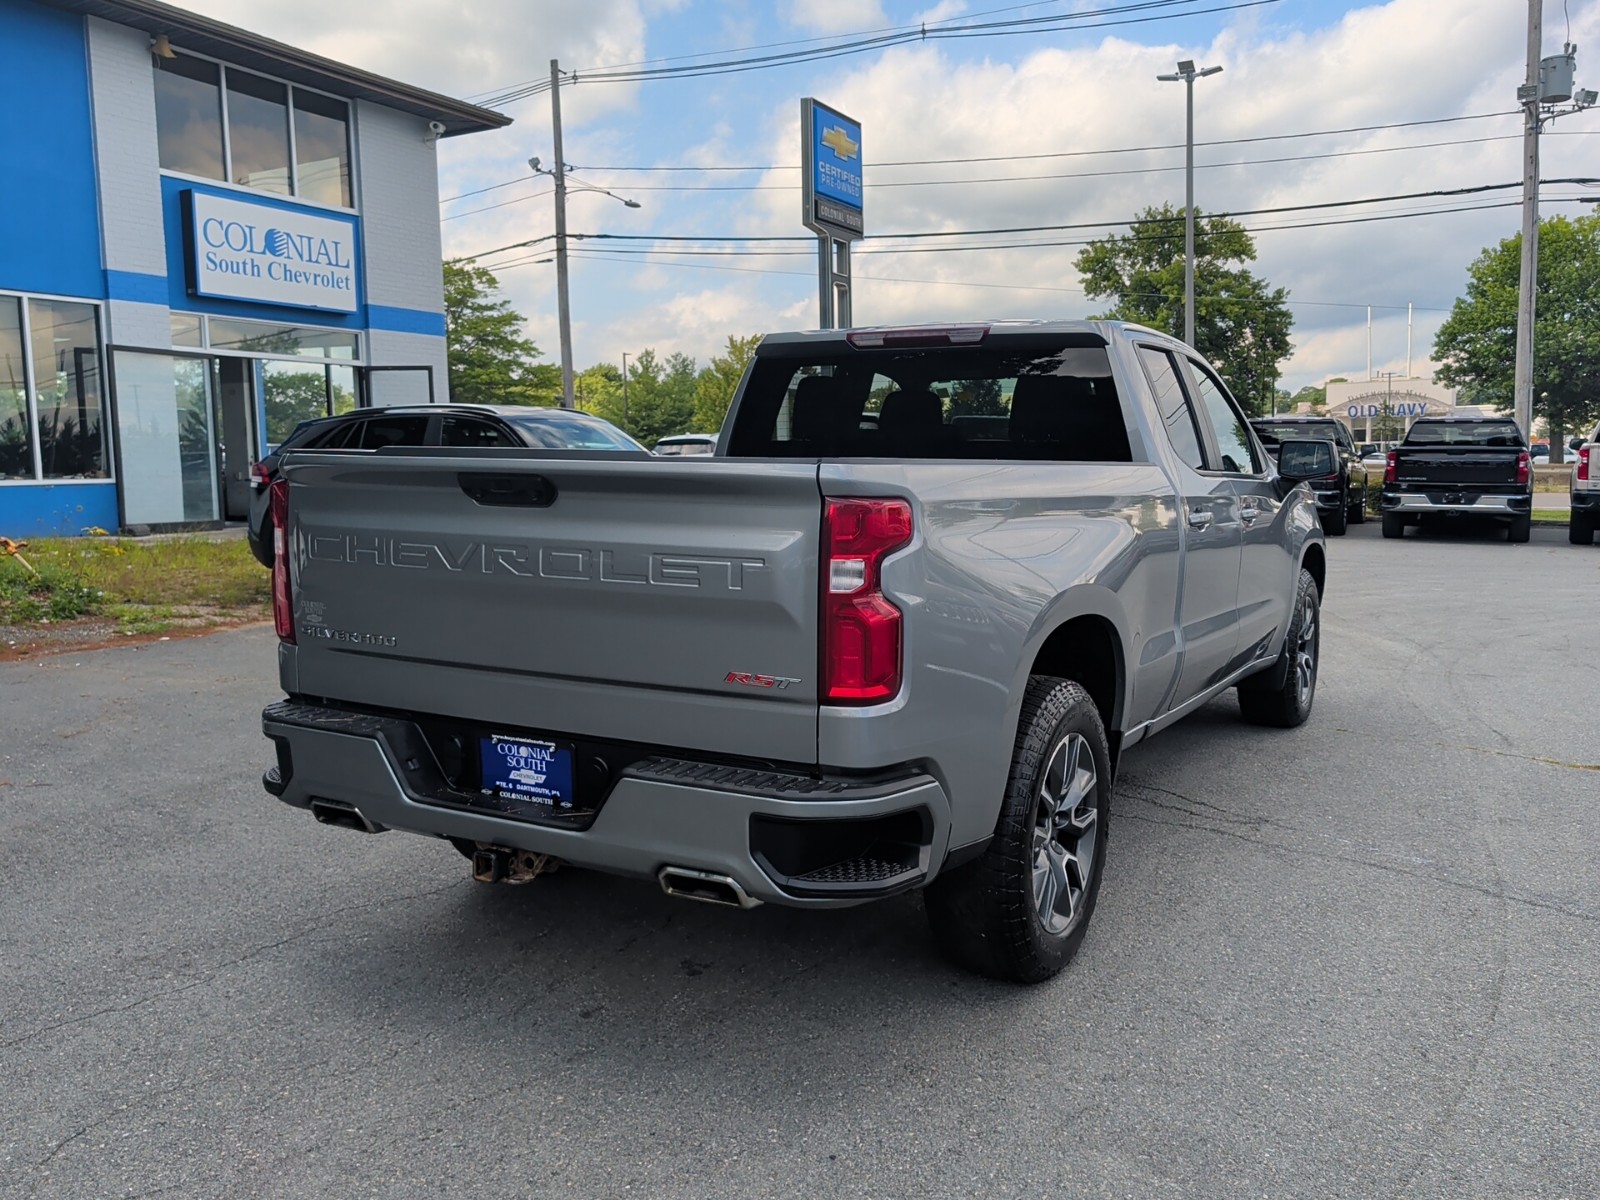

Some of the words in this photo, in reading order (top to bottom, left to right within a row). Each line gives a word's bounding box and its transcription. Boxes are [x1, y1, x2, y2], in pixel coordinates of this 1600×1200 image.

[819, 161, 861, 187] CERTIFIED
[821, 174, 860, 198] PRE-OWNED
[820, 206, 845, 222] COLONIAL
[846, 213, 861, 227] SOUTH
[203, 217, 350, 269] COLONIAL
[206, 251, 261, 278] South
[267, 261, 351, 291] Chevrolet
[1347, 404, 1378, 418] OLD
[1384, 402, 1427, 416] NAVY
[307, 532, 767, 591] CHEVROLET
[301, 627, 397, 647] SILVERADO
[724, 671, 802, 689] RST
[497, 743, 555, 762] COLONIAL
[507, 755, 547, 772] SOUTH
[508, 782, 513, 790] 6
[512, 772, 543, 781] CHEVROLET
[499, 791, 531, 802] COLONIAL
[531, 796, 554, 806] SOUTH
